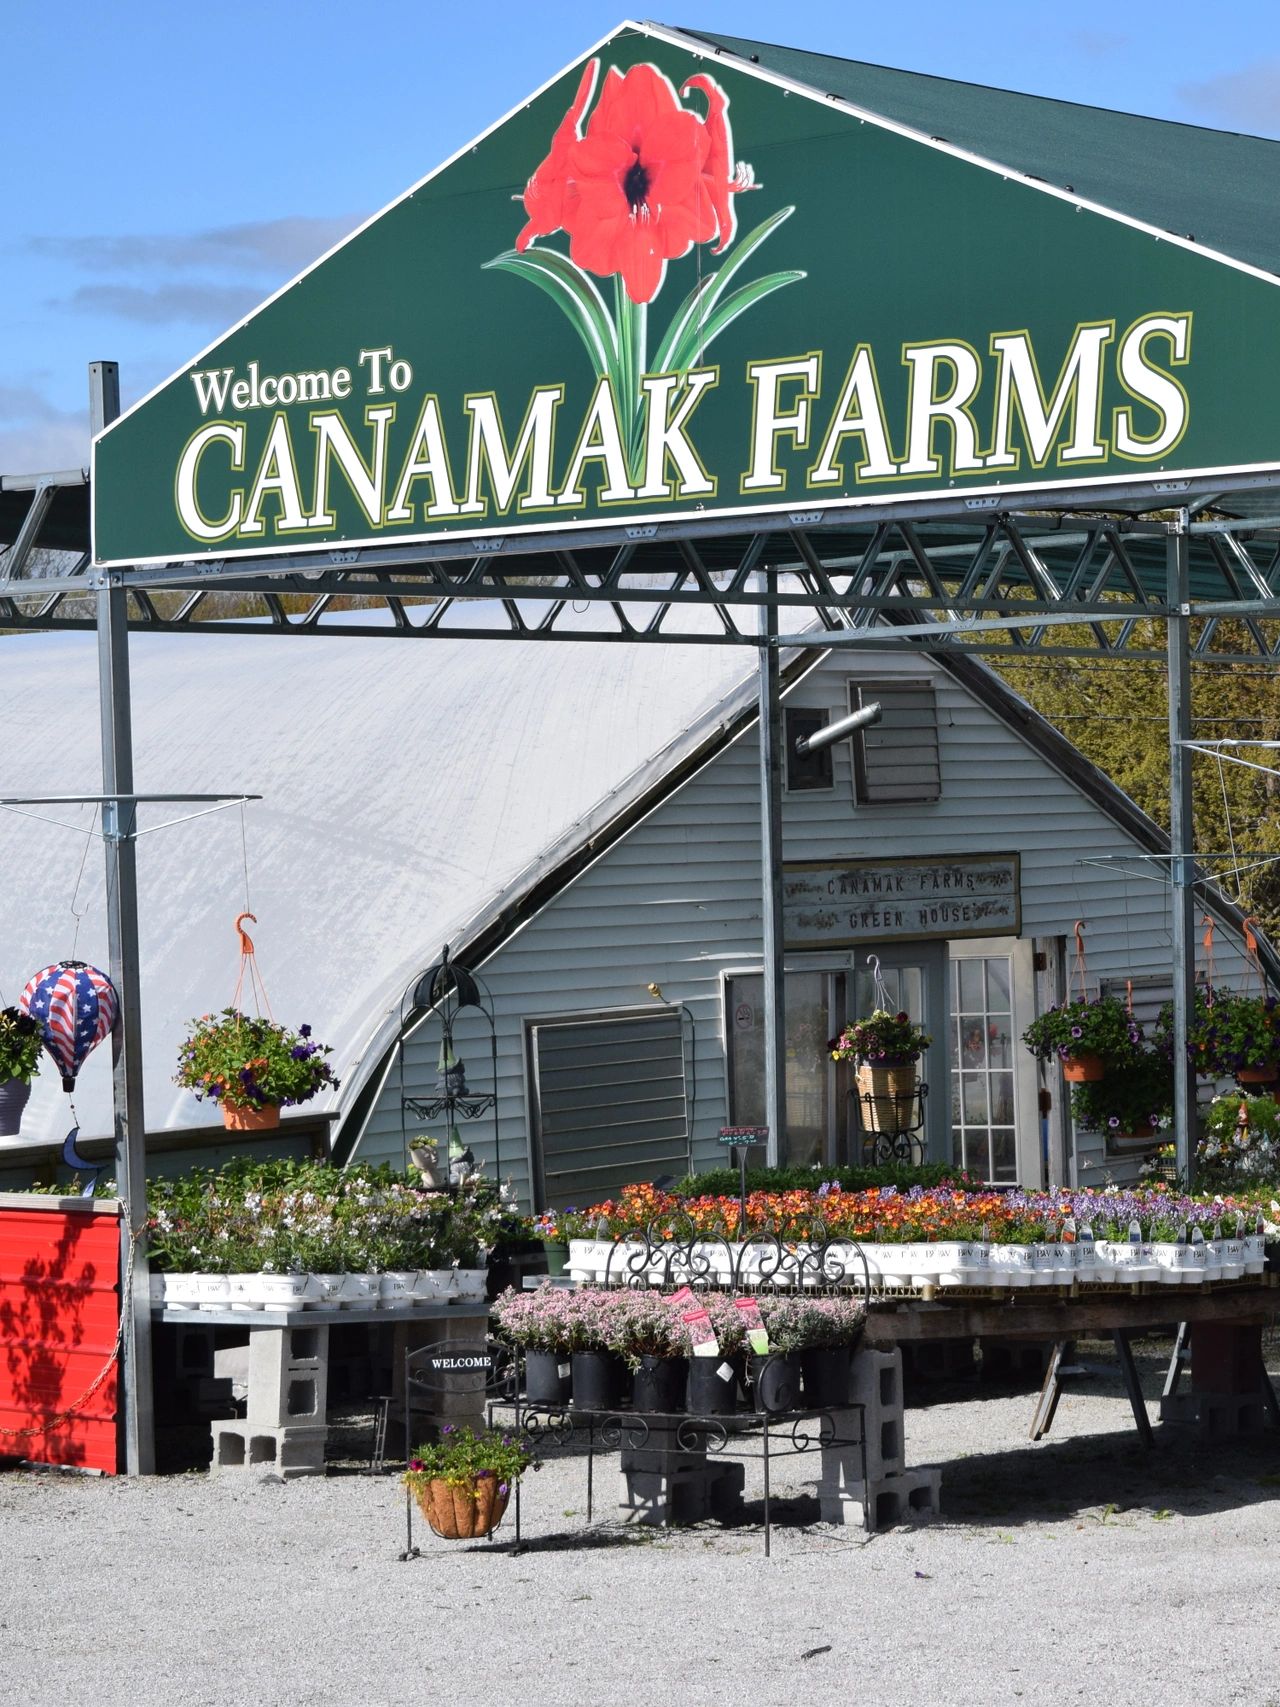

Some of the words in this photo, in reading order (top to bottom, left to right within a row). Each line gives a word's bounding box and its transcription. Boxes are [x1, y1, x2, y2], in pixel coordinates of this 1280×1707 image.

[191, 363, 353, 413] Welcome
[357, 346, 413, 396] To
[174, 365, 718, 543] CANAMAK
[738, 310, 1194, 493] FARMS
[826, 874, 905, 896] CANAMAK
[919, 872, 975, 890] FARMS
[849, 910, 904, 929] GREEN
[919, 906, 971, 926] HOUSE
[432, 1357, 492, 1369] WELCOME
